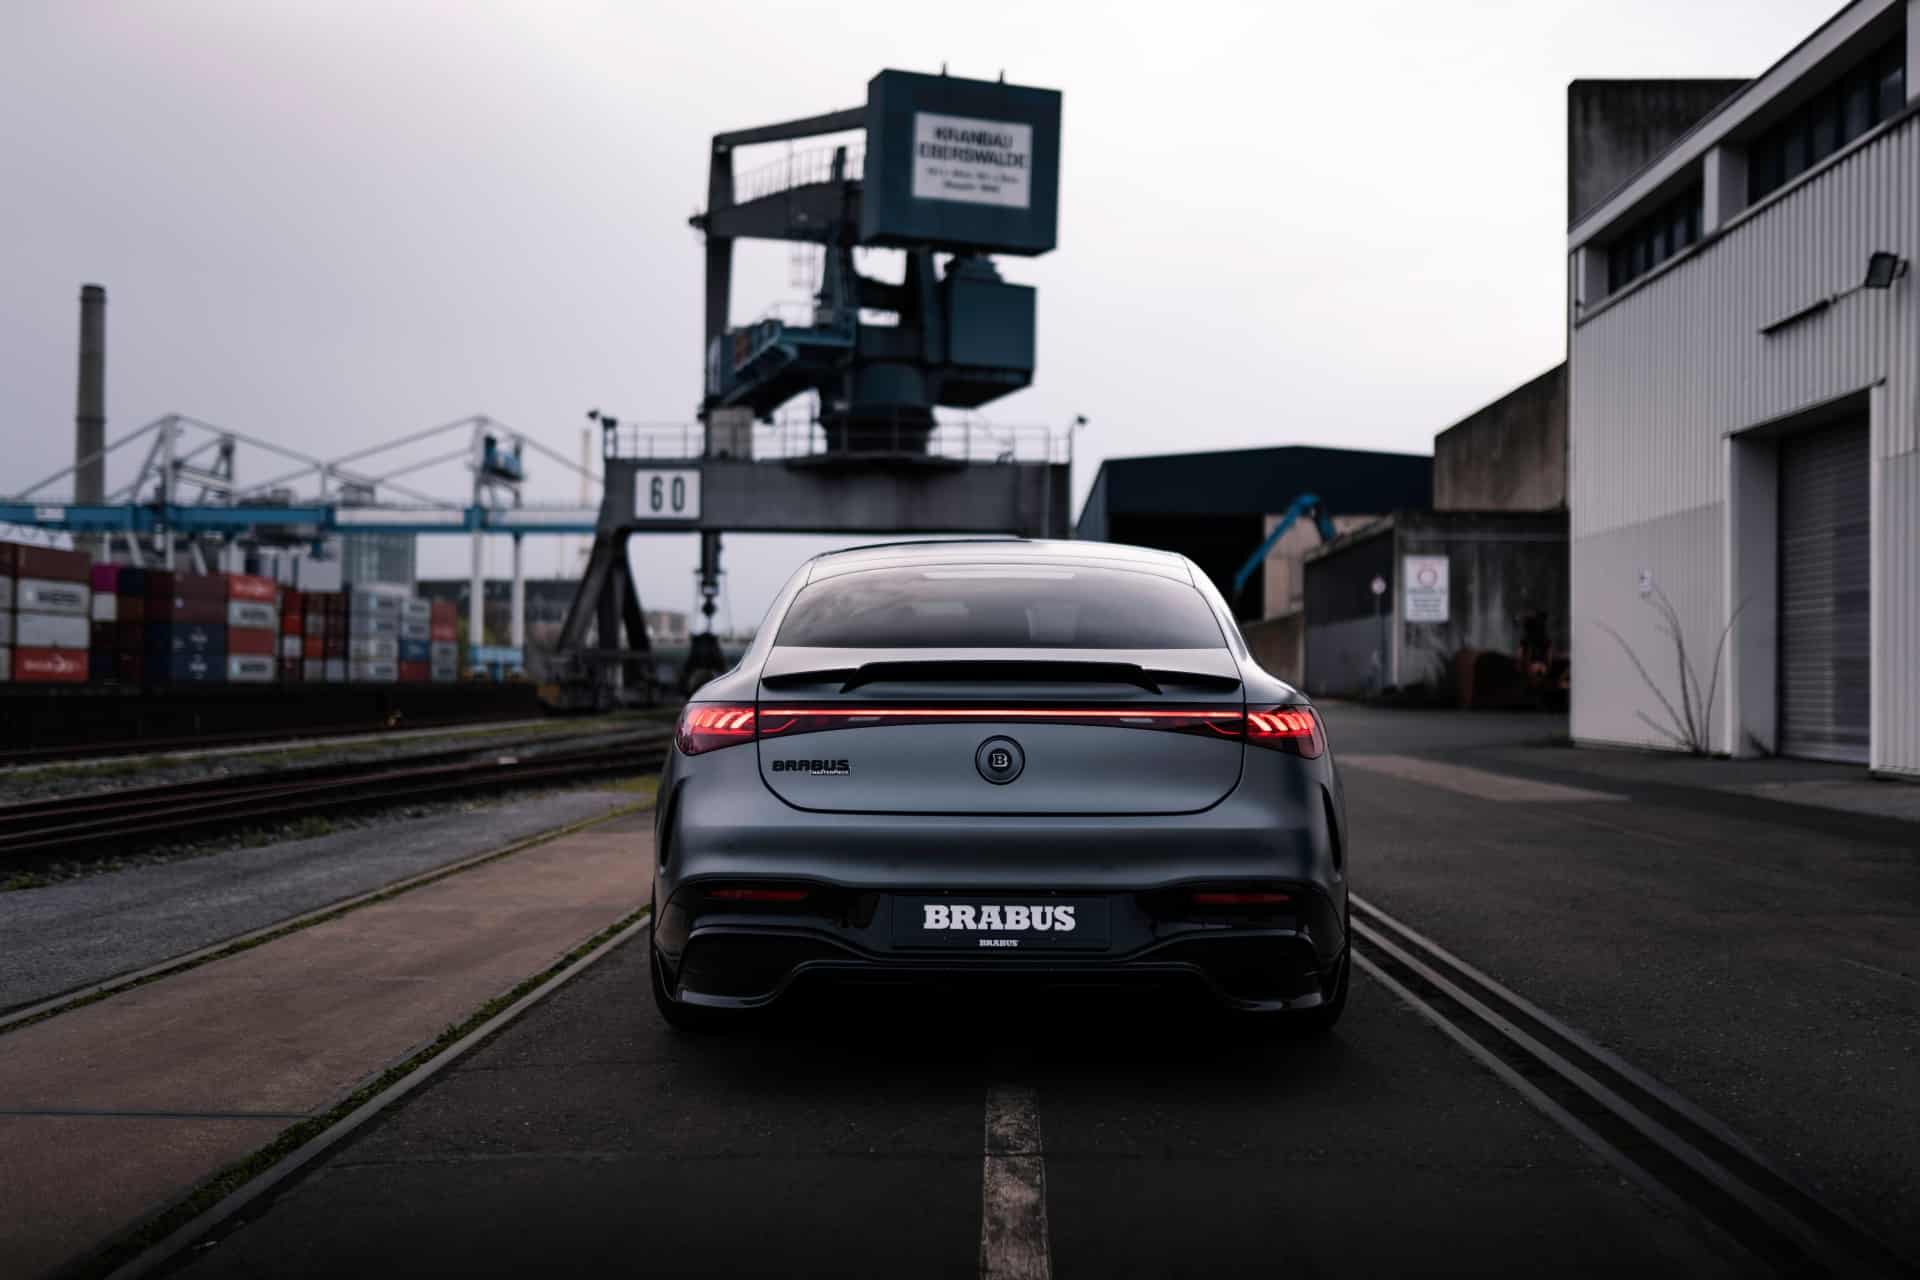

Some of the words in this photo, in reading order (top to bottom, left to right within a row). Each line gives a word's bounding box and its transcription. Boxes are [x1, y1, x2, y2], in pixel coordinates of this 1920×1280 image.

[650, 475, 686, 512] 60
[772, 759, 850, 772] BRABUS
[923, 904, 1077, 932] BRABUS
[979, 939, 1019, 947] BRABUS
